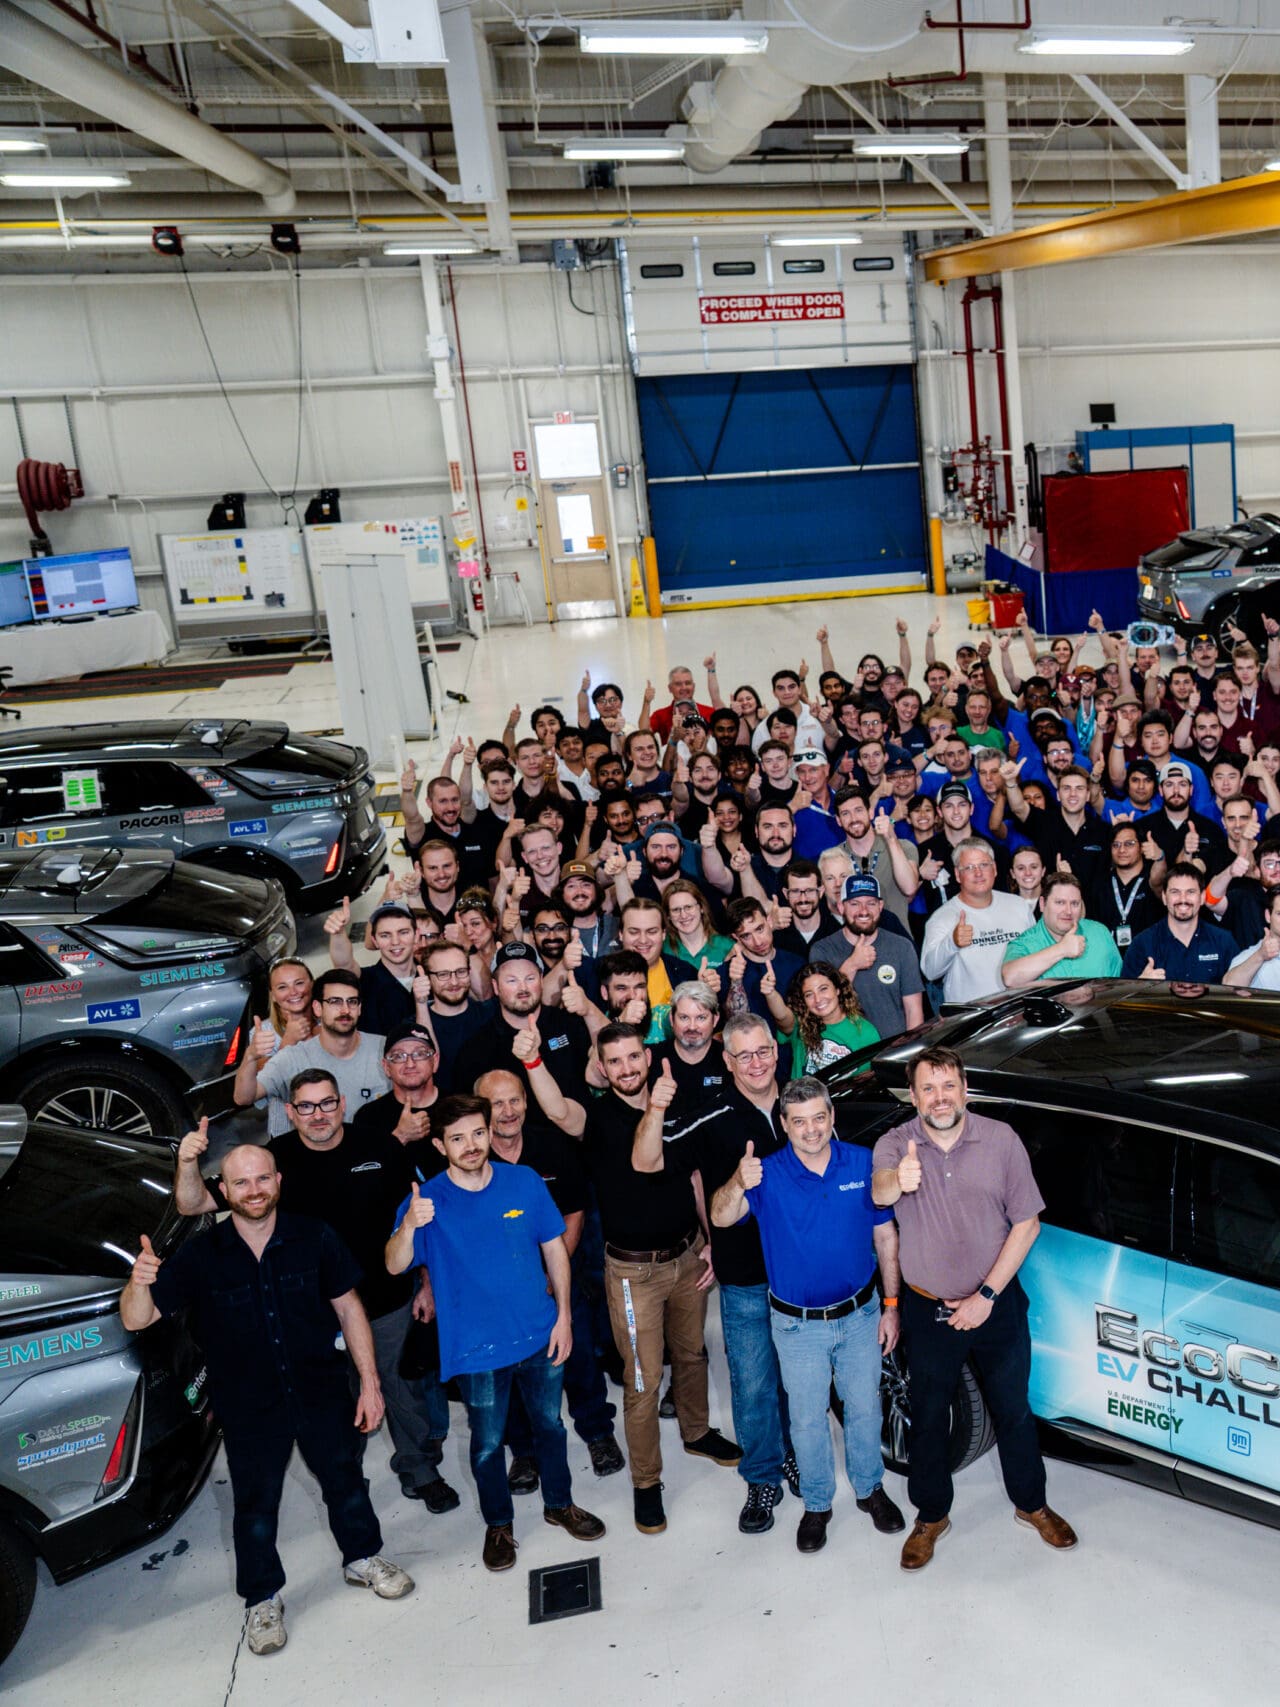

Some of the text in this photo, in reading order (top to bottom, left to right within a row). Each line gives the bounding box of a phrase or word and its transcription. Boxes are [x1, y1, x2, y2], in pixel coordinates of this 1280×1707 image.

[700, 294, 842, 309] PROCEED WHEN DOOR
[703, 307, 841, 322] IS COMPLETELY OPEN
[184, 808, 225, 820] DENSO
[272, 797, 333, 814] SIEMENS
[119, 814, 180, 830] PACCAR
[233, 825, 250, 833] AVL
[17, 828, 66, 847] NXP
[972, 932, 1020, 945] ONNECTED
[58, 943, 84, 953] Altec
[140, 962, 226, 987] SIEMENS
[25, 980, 84, 998] DENSO
[94, 1008, 117, 1019] AVL
[0, 1284, 42, 1301] FFLER
[0, 1326, 103, 1369] EMENS
[1097, 1352, 1139, 1383] EV
[1107, 1390, 1119, 1398] U.S.
[1122, 1393, 1166, 1411] DEPARTMENT
[1107, 1397, 1184, 1434] ENERGY
[38, 1415, 101, 1438] DATASPEED
[17, 1433, 105, 1465] speedgoat
